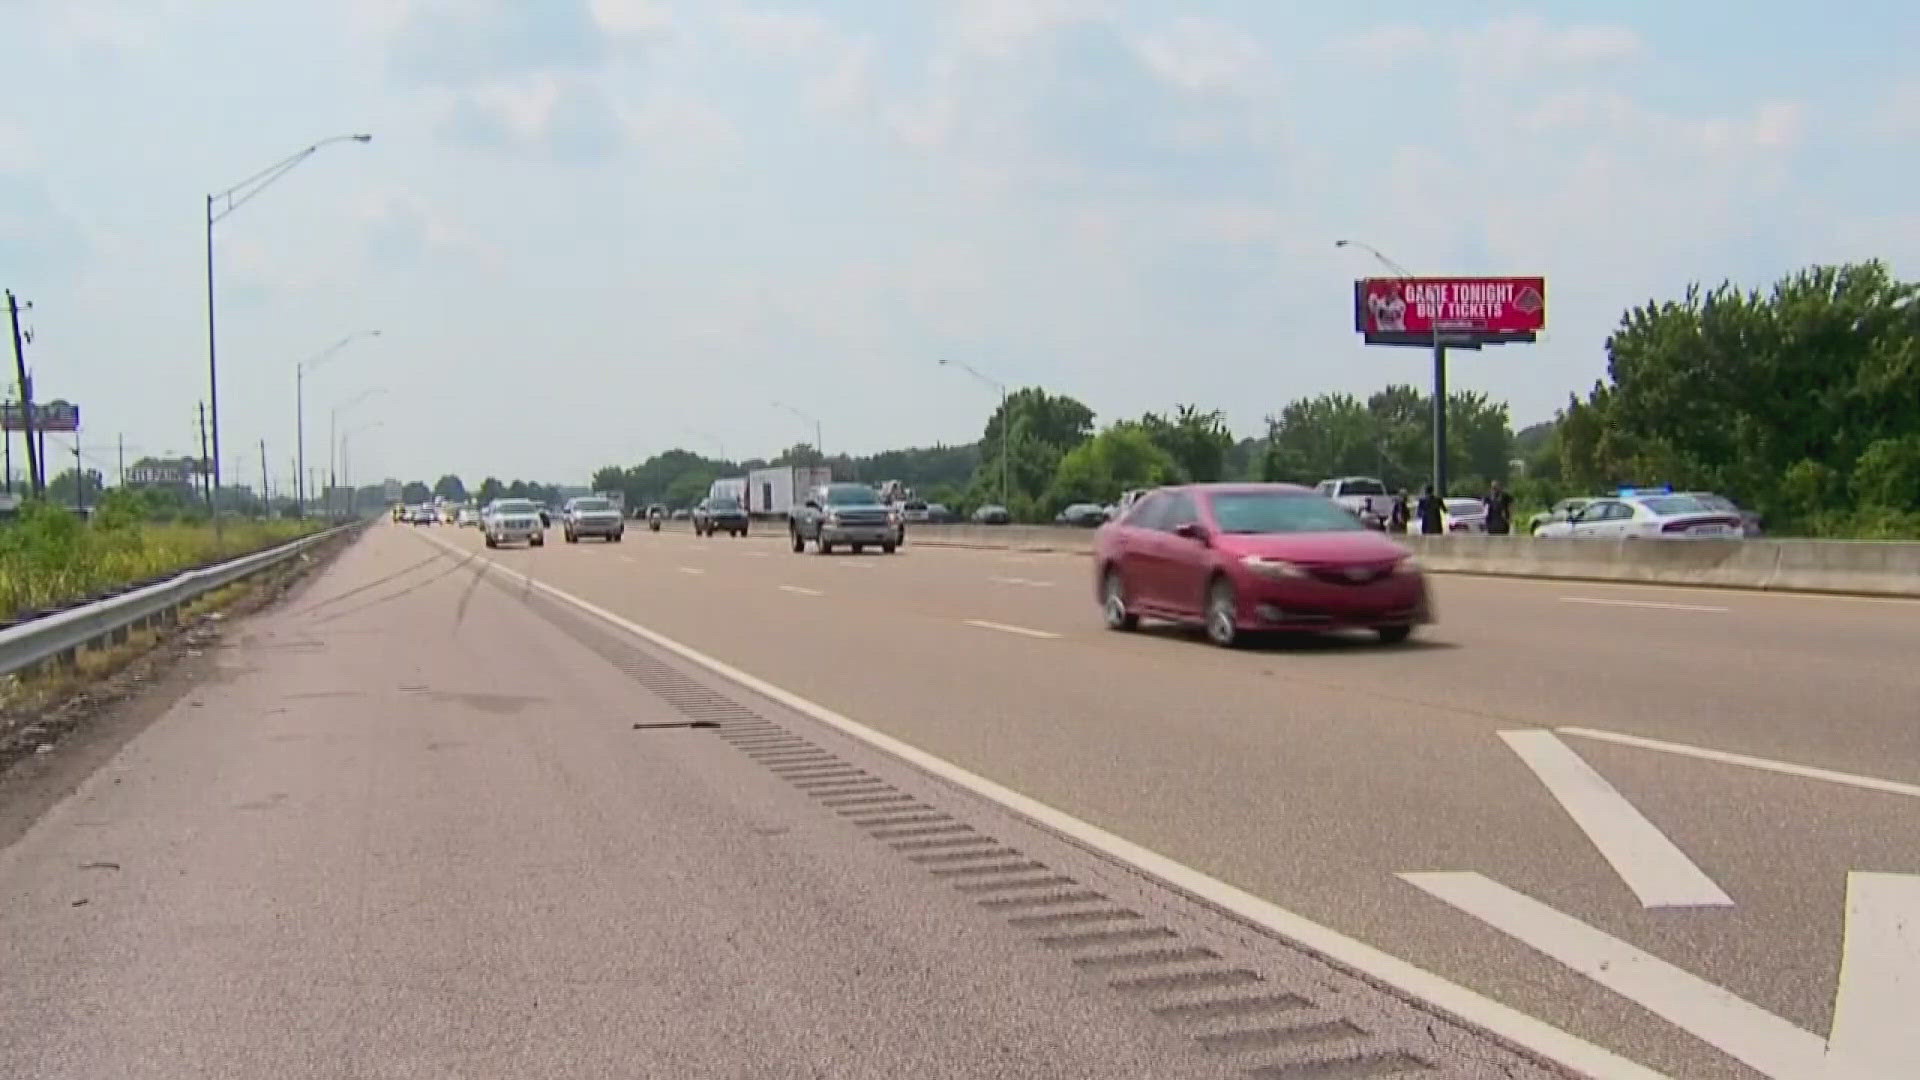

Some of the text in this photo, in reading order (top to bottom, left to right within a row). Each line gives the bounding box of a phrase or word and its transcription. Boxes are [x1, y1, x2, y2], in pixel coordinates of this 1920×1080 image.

[1405, 284, 1514, 303] GAME TONIGHT
[1416, 303, 1503, 318] BUY TICKETS
